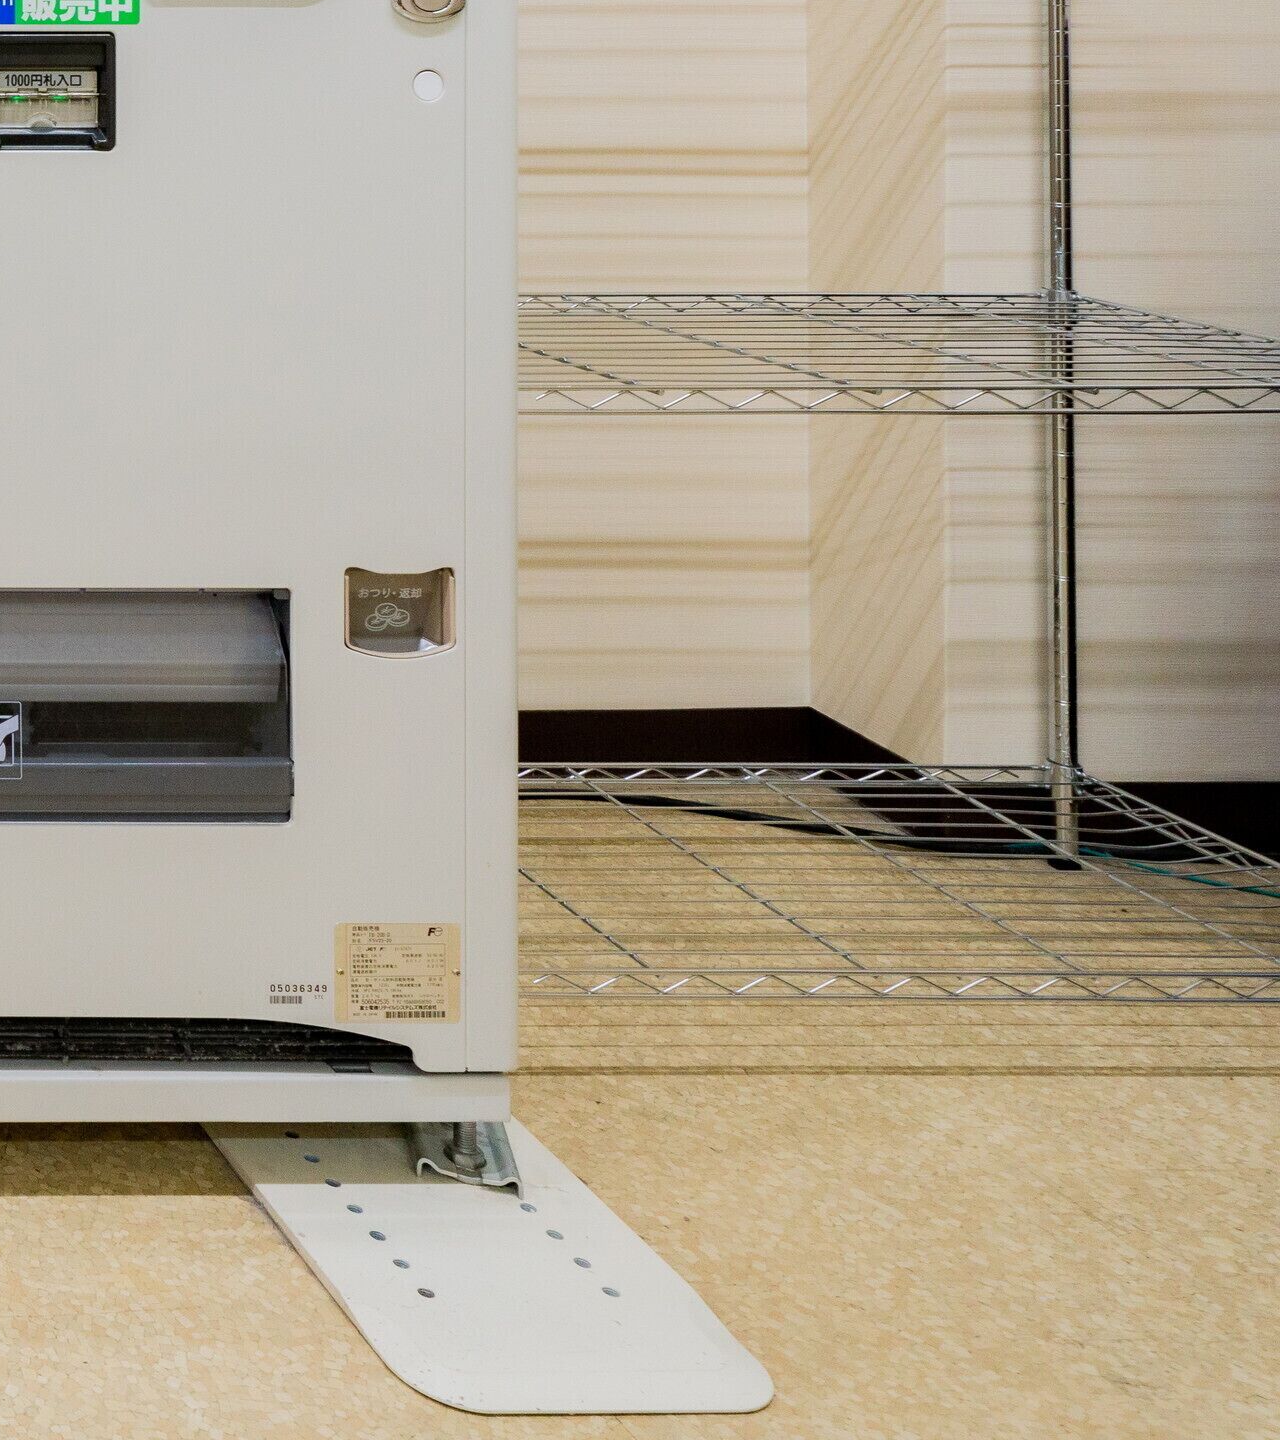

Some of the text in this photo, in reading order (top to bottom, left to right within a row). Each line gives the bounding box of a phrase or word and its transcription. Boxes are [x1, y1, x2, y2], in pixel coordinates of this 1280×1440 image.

[4, 73, 83, 88] 1000円札入口
[270, 984, 328, 992] 05036349
